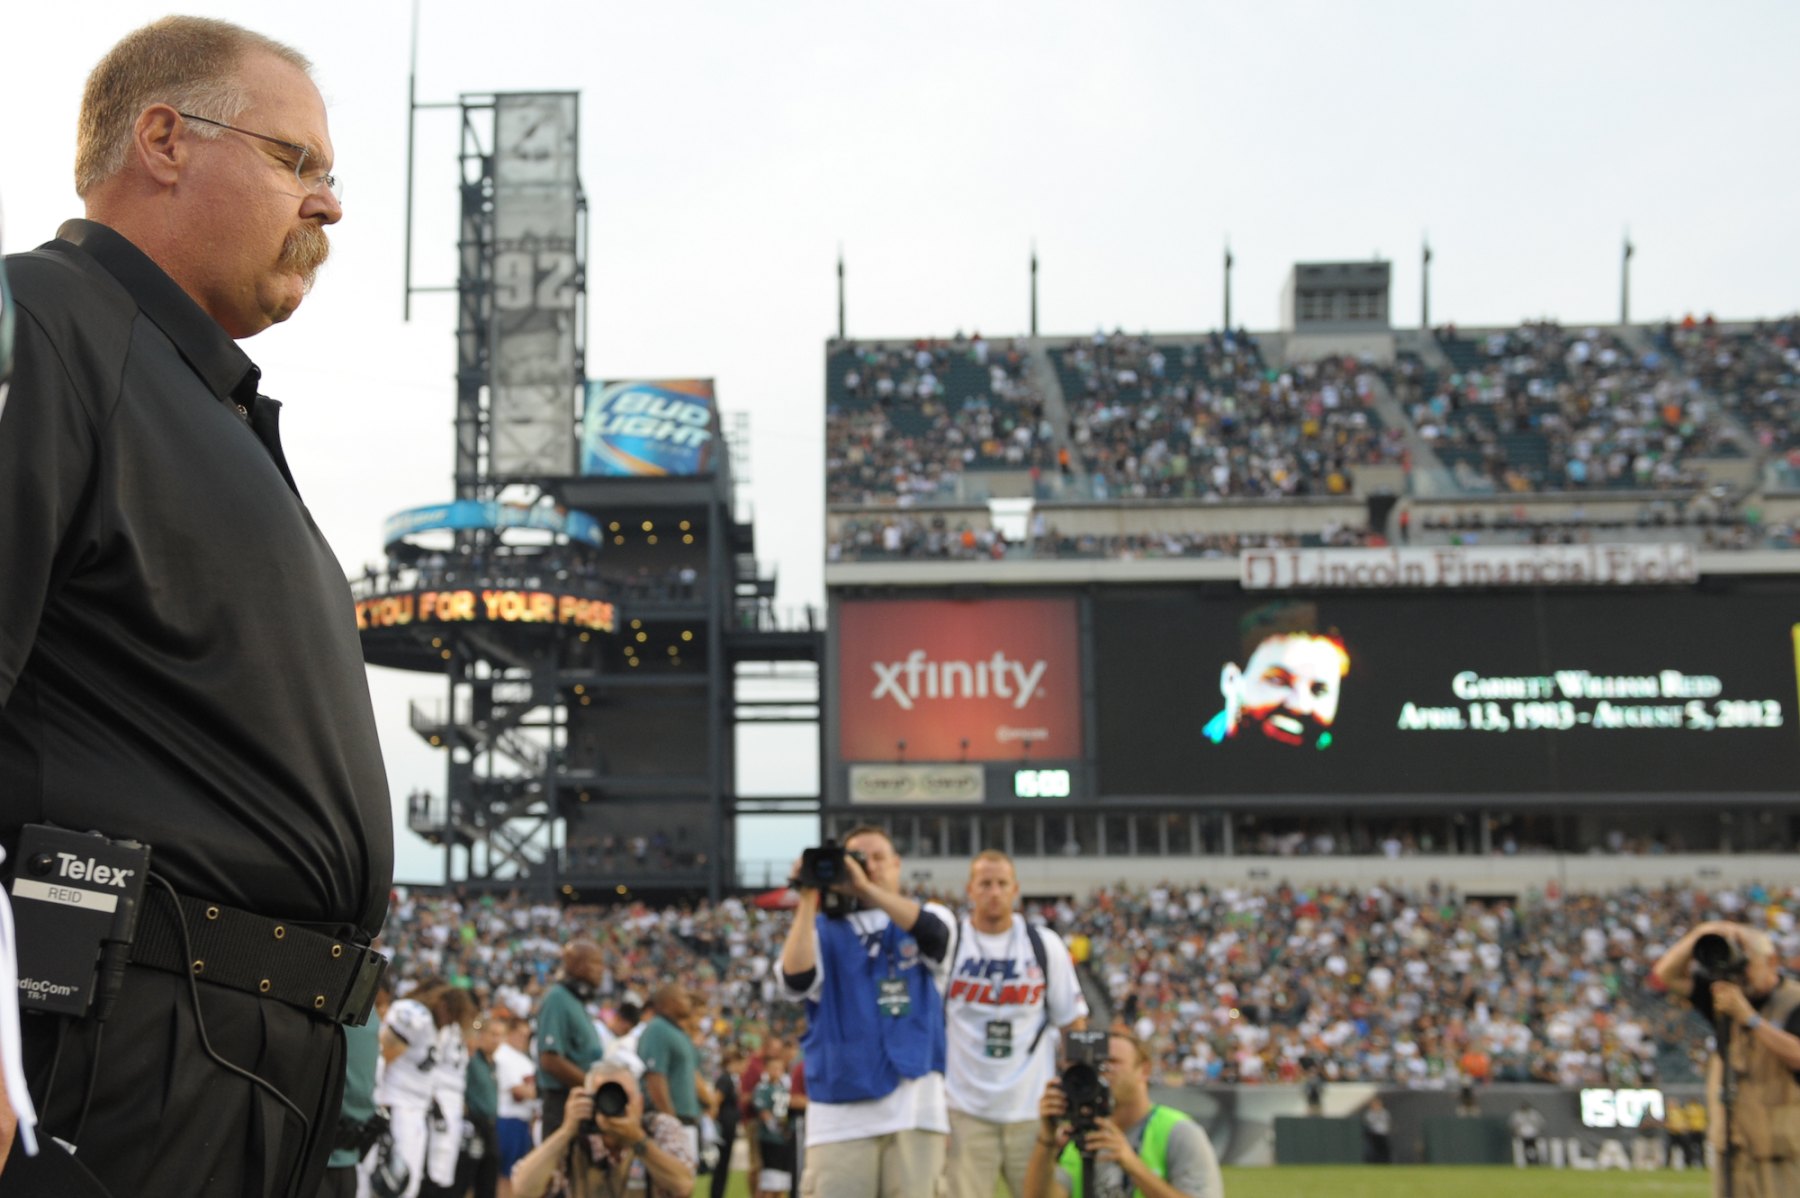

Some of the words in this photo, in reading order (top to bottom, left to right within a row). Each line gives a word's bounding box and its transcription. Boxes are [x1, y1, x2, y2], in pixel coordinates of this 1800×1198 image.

[494, 252, 576, 310] 92
[613, 391, 712, 427] BUD
[594, 411, 713, 448] LIGHT
[1288, 548, 1427, 588] Lincoln
[1434, 546, 1598, 587] Financial
[1605, 543, 1698, 585] Field
[366, 596, 414, 626] YOU
[419, 589, 476, 622] FOR
[482, 589, 556, 624] YOUR
[871, 649, 1049, 710] xfinity
[47, 887, 82, 904] REID
[959, 958, 1020, 981] NFL
[950, 980, 1047, 1007] FILMS
